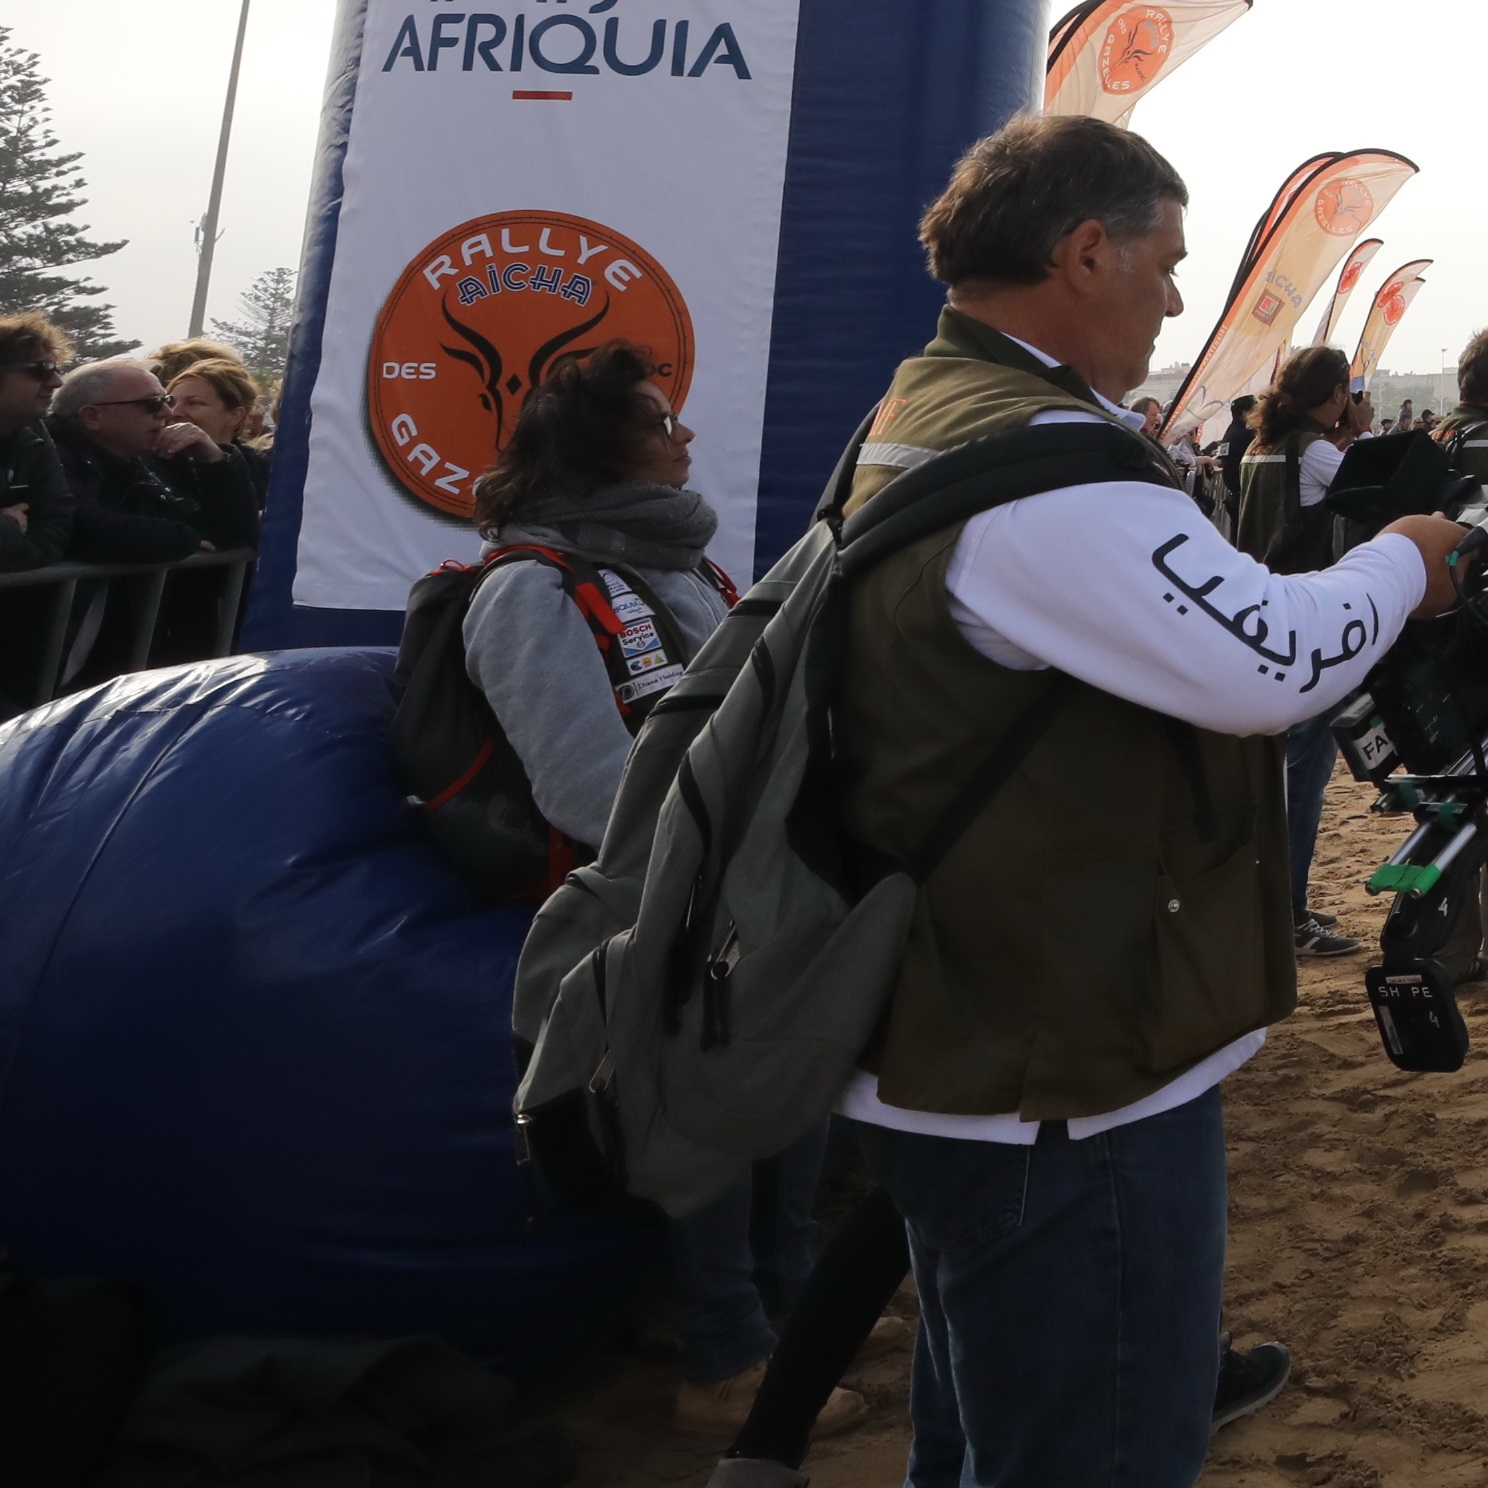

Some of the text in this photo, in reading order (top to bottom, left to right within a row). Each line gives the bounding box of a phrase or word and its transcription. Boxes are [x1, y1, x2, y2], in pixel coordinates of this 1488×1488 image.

[382, 13, 752, 80] AFRIQUIA
[1102, 34, 1130, 89] GAZELLES
[422, 228, 642, 292] RALLYE
[383, 362, 437, 380] DES
[622, 631, 654, 646] Service
